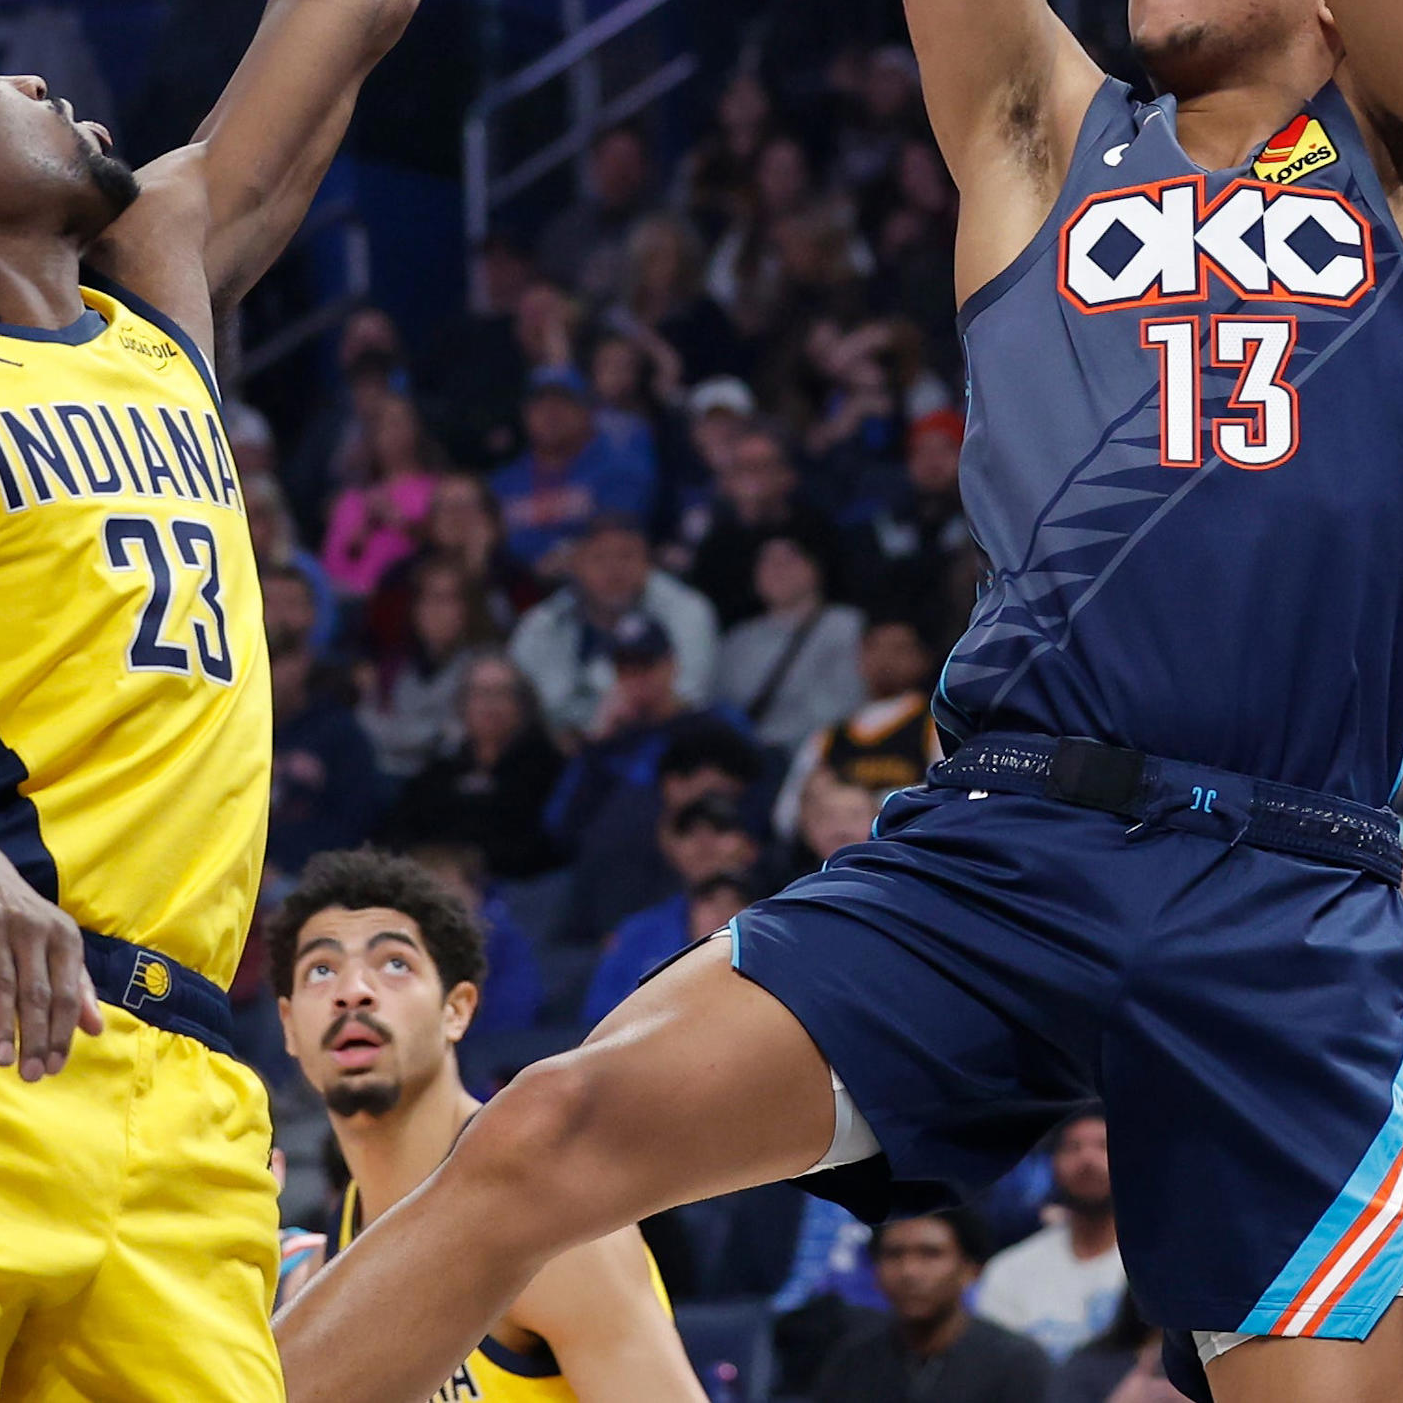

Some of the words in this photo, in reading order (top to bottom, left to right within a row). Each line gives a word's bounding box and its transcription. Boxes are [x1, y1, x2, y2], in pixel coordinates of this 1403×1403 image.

[1062, 178, 1374, 312] OKC
[118, 334, 152, 358] LUCAS
[152, 342, 178, 359] OIL
[1141, 316, 1300, 470] 13
[101, 512, 236, 687] 23
